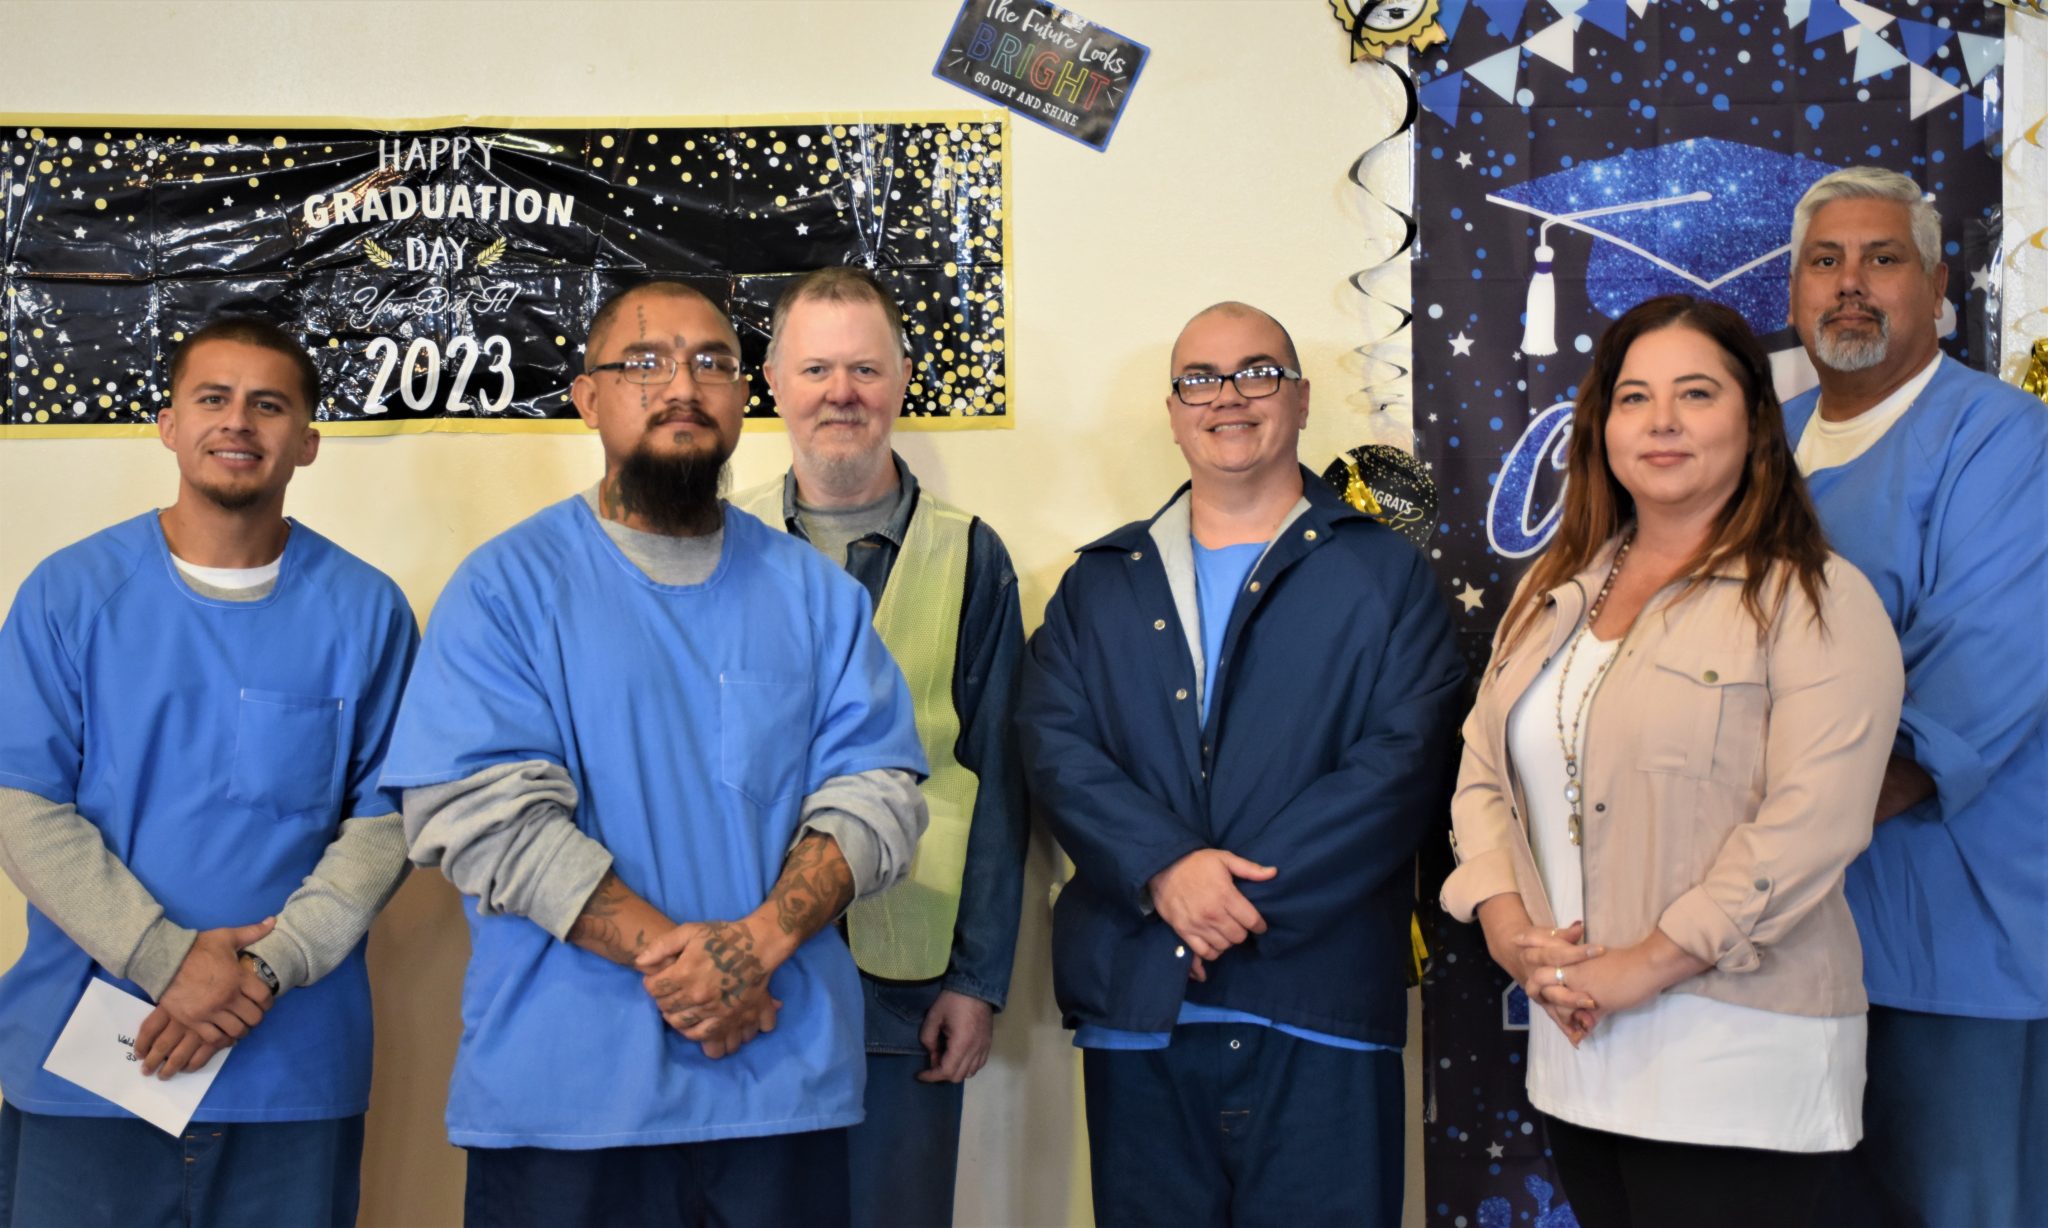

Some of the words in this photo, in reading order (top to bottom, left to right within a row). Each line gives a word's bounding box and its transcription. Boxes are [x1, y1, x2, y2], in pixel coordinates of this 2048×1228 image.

[987, 0, 1019, 23] The
[1022, 8, 1077, 49] Future
[1079, 38, 1126, 74] Looks
[967, 22, 1111, 112] BRIGHT
[974, 72, 990, 86] GO
[992, 81, 1017, 100] OUT
[1017, 91, 1042, 109] AND
[1043, 103, 1079, 127] SHINE
[378, 136, 497, 172] HAPPY
[302, 184, 575, 229] GRADUATION
[405, 236, 469, 271] DAY
[350, 286, 408, 330] You
[412, 286, 473, 316] Did
[473, 286, 522, 314] It!
[362, 335, 515, 415] 2023
[1368, 486, 1414, 515] NGRATS
